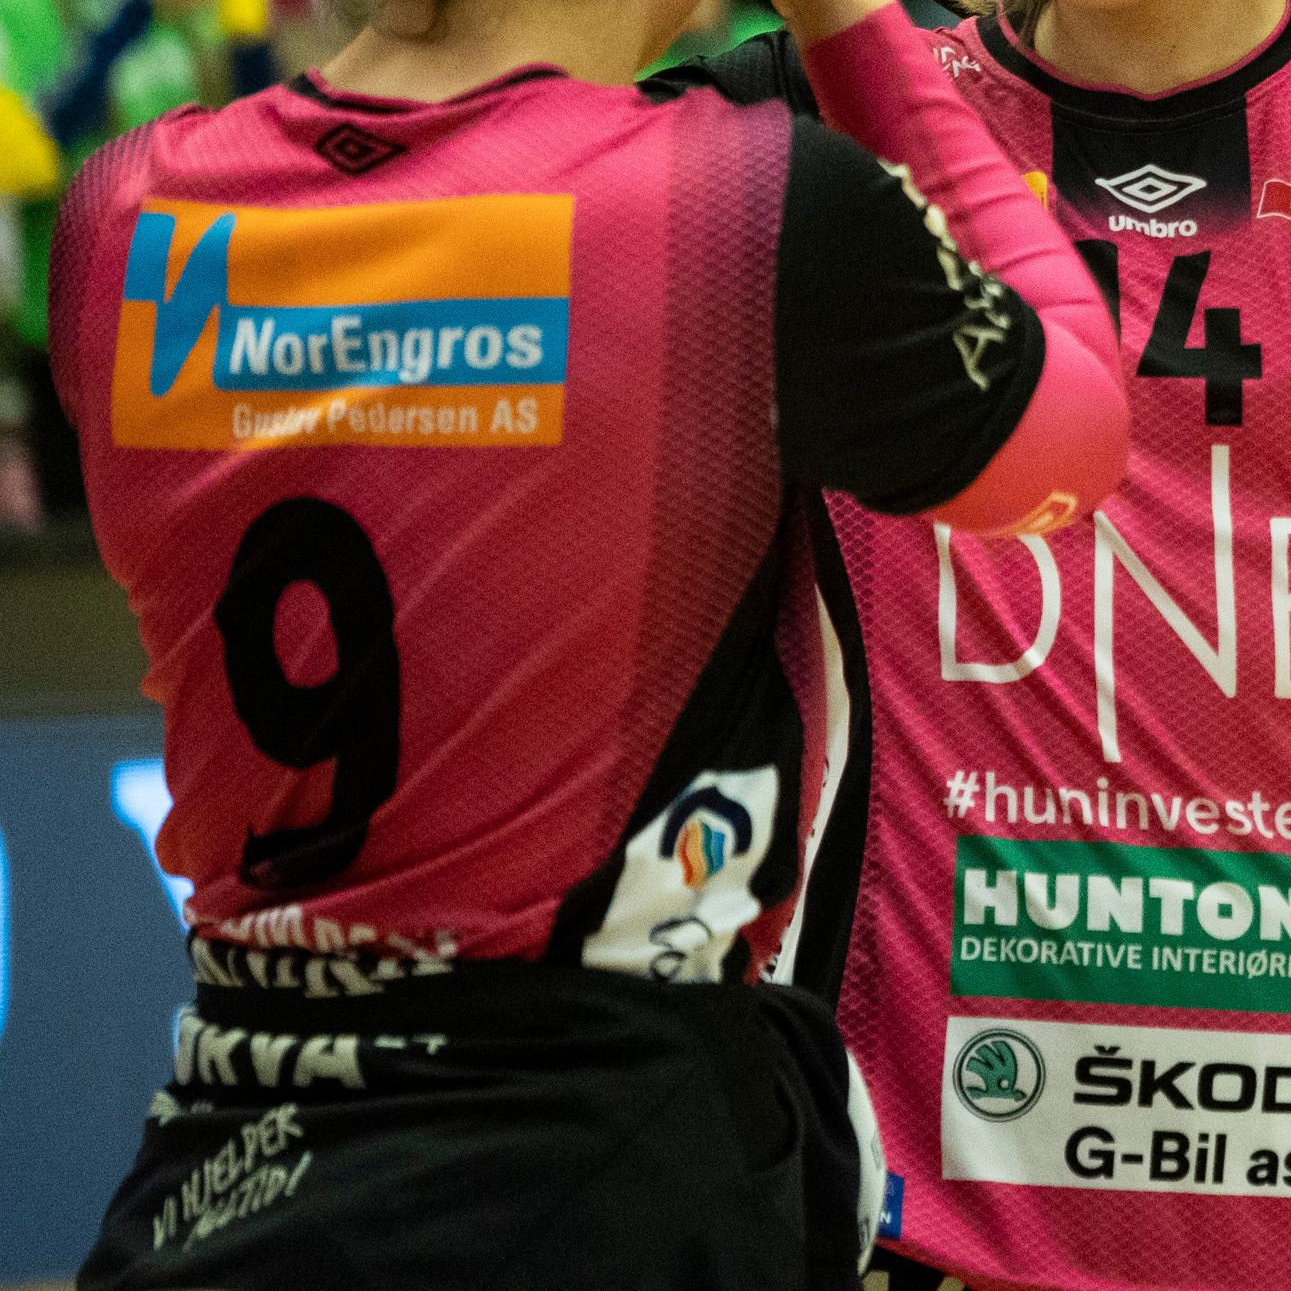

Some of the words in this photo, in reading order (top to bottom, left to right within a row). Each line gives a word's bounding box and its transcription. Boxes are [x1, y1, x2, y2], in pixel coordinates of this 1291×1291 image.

[1108, 215, 1198, 239] umbro
[229, 313, 544, 385] NorEngros
[490, 395, 540, 435] AS
[213, 495, 402, 890] 9
[960, 937, 1143, 971] DEKORATIVE
[1064, 1125, 1229, 1186] G-Bil
